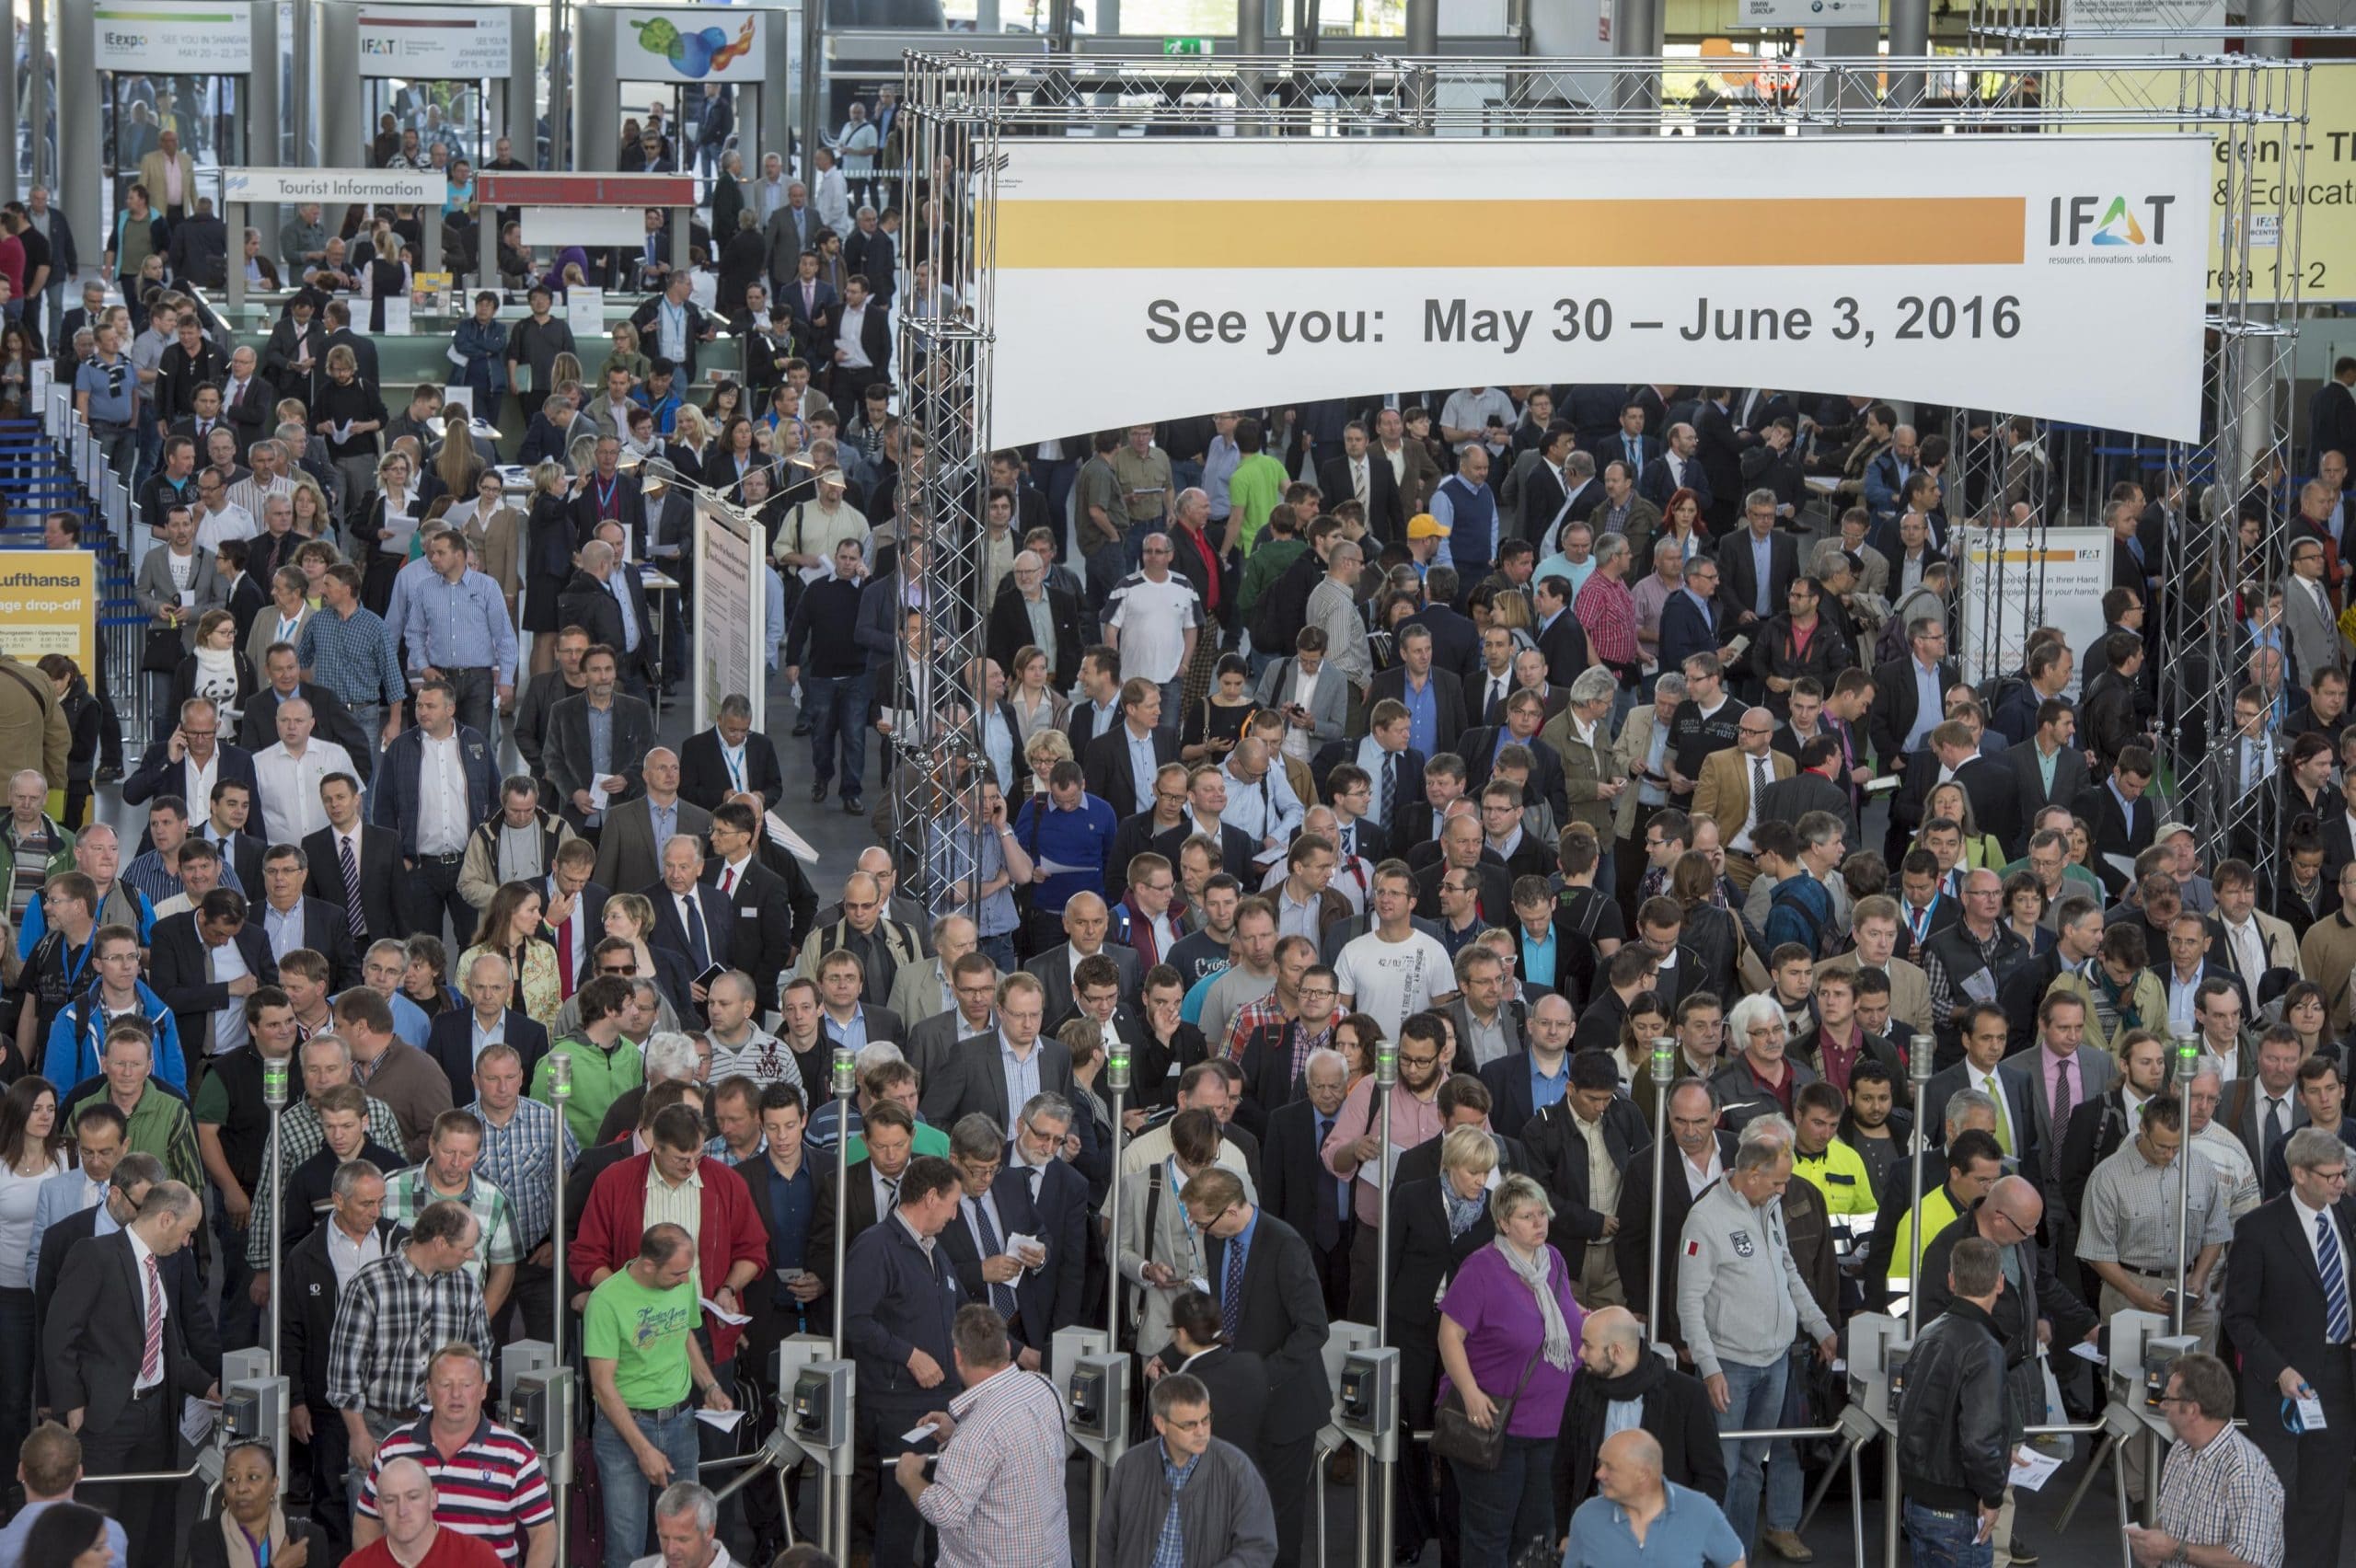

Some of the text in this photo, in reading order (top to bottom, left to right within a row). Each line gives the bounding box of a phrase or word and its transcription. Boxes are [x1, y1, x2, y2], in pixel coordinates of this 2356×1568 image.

[180, 34, 199, 44] YOU
[362, 39, 395, 54] IFAT
[278, 179, 423, 196] Tourist Information
[2249, 179, 2356, 205] Educat
[2050, 196, 2176, 247] IFAT
[2049, 254, 2174, 265] resources. innovations. solutions.
[1146, 299, 1247, 344] See
[1265, 310, 1384, 355] you:
[1424, 298, 1533, 354] May
[1552, 298, 1612, 342] 30
[1680, 297, 1812, 341] June
[1831, 296, 1875, 349] 3,
[1895, 294, 2021, 340] 2016
[26, 599, 81, 614] drop-off
